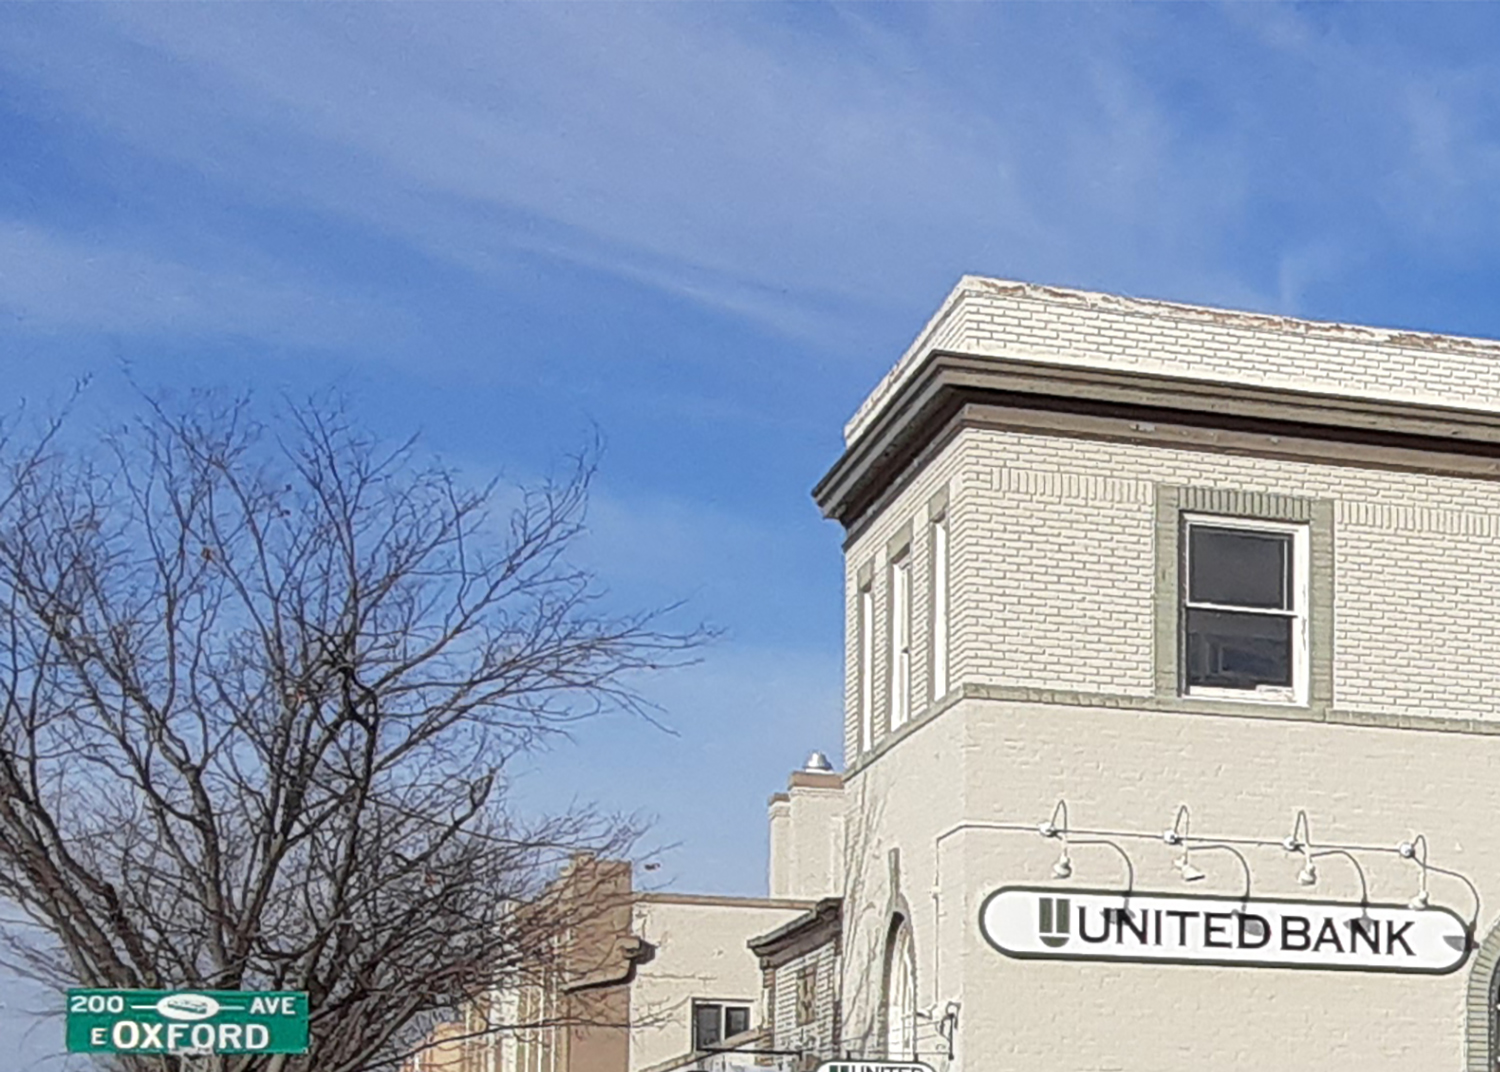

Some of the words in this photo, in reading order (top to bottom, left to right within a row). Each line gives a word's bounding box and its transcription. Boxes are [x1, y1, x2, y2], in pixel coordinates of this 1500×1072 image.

[1077, 904, 1272, 951] UNITED
[1279, 914, 1417, 957] BANK
[70, 995, 124, 1013] 200
[250, 996, 296, 1015] AVE
[91, 1027, 108, 1045] E
[112, 1020, 270, 1050] OXFORD
